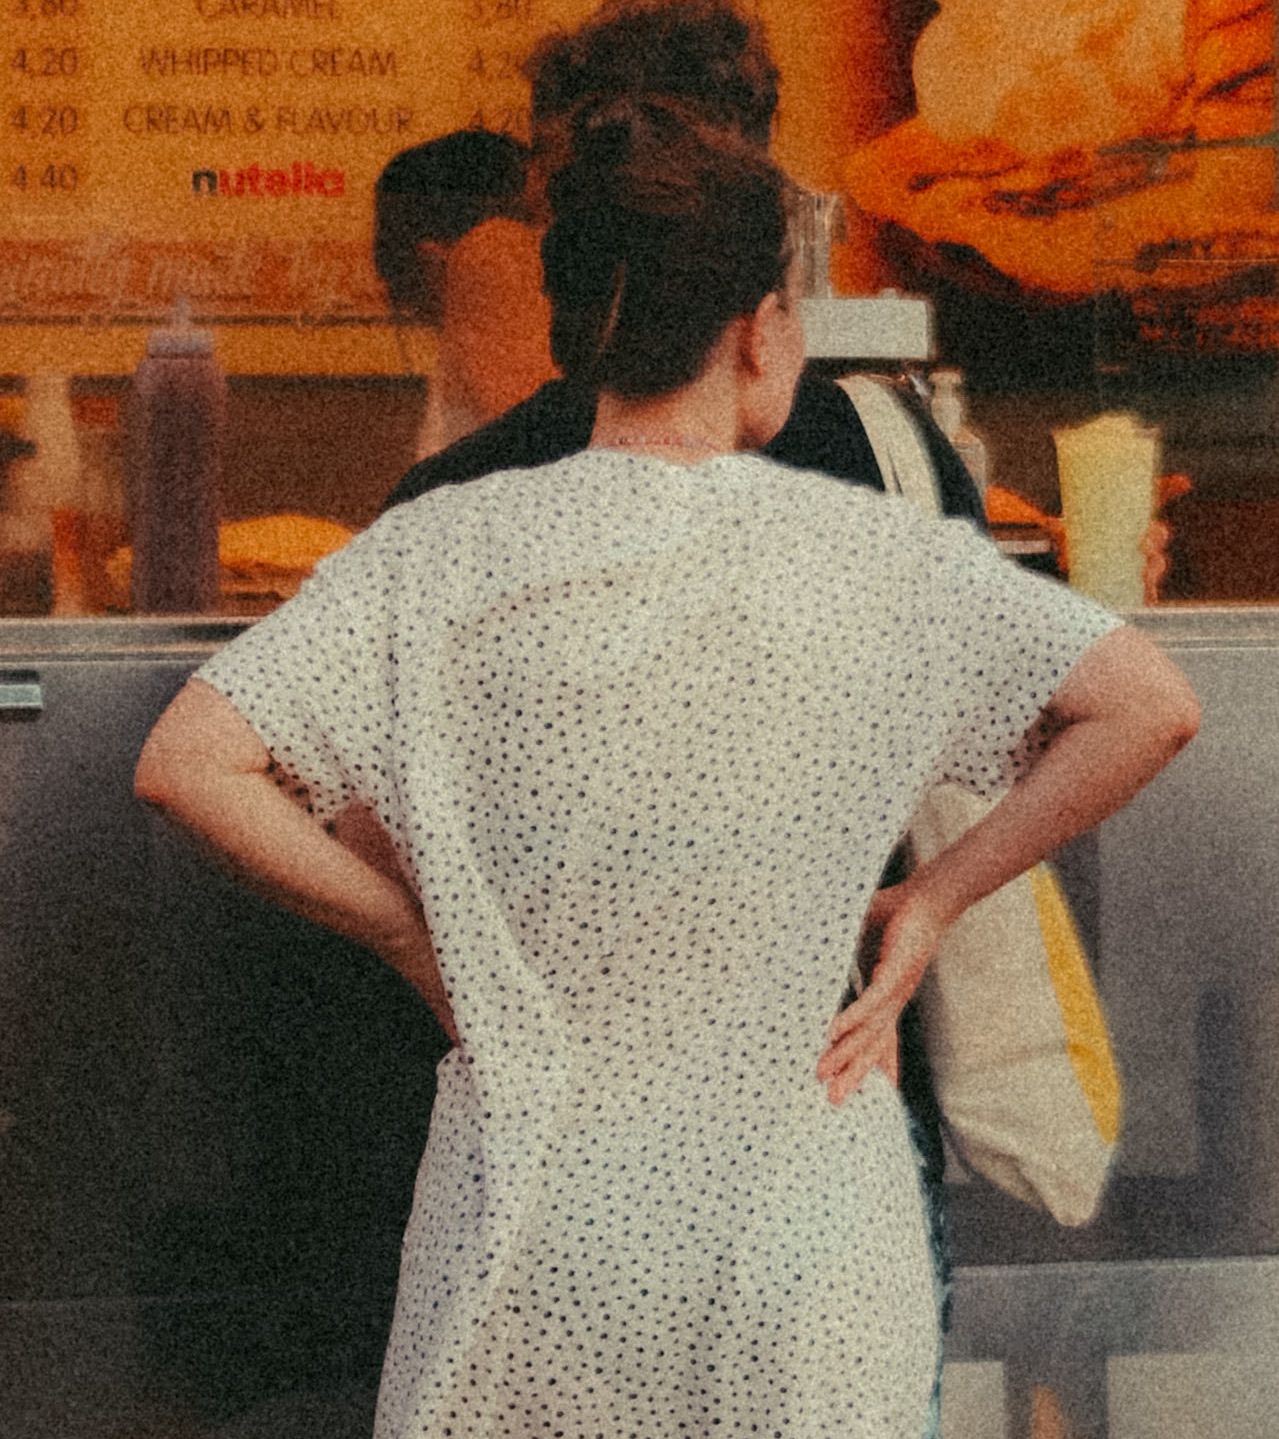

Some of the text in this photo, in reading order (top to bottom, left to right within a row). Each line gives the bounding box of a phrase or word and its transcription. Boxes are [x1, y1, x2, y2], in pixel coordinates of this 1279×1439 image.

[141, 47, 397, 77] WHIPPED CREAM
[122, 106, 414, 136] CREAM & FLAVOUR
[192, 161, 345, 197] nutella
